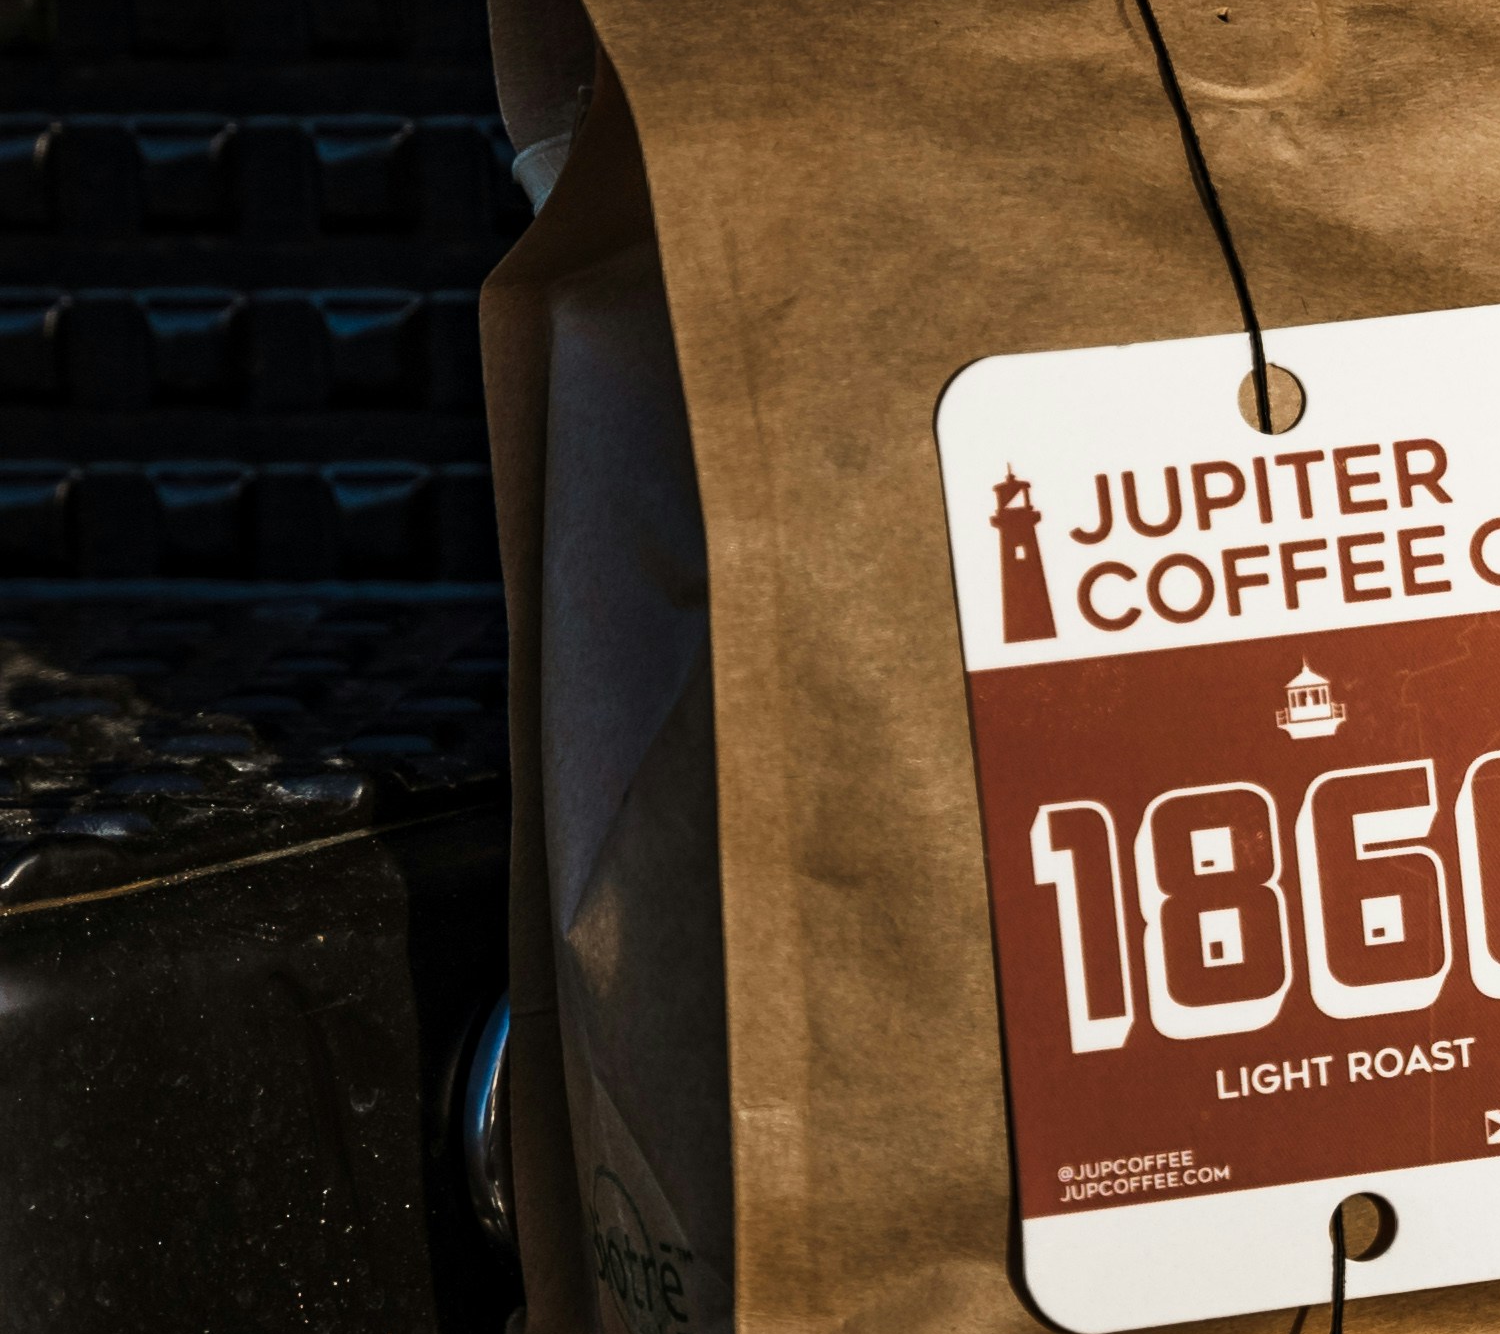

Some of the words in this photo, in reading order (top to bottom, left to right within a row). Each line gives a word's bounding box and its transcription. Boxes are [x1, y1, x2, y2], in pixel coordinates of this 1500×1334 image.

[1070, 439, 1453, 545] JUPITER
[1078, 525, 1451, 631] COFFEE
[1216, 1056, 1332, 1099] LIGHT
[1348, 1038, 1474, 1082] ROAST
[1058, 1150, 1193, 1182] @JUPCOFFEE
[1061, 1166, 1230, 1201] JUPCOFFEE.COM
